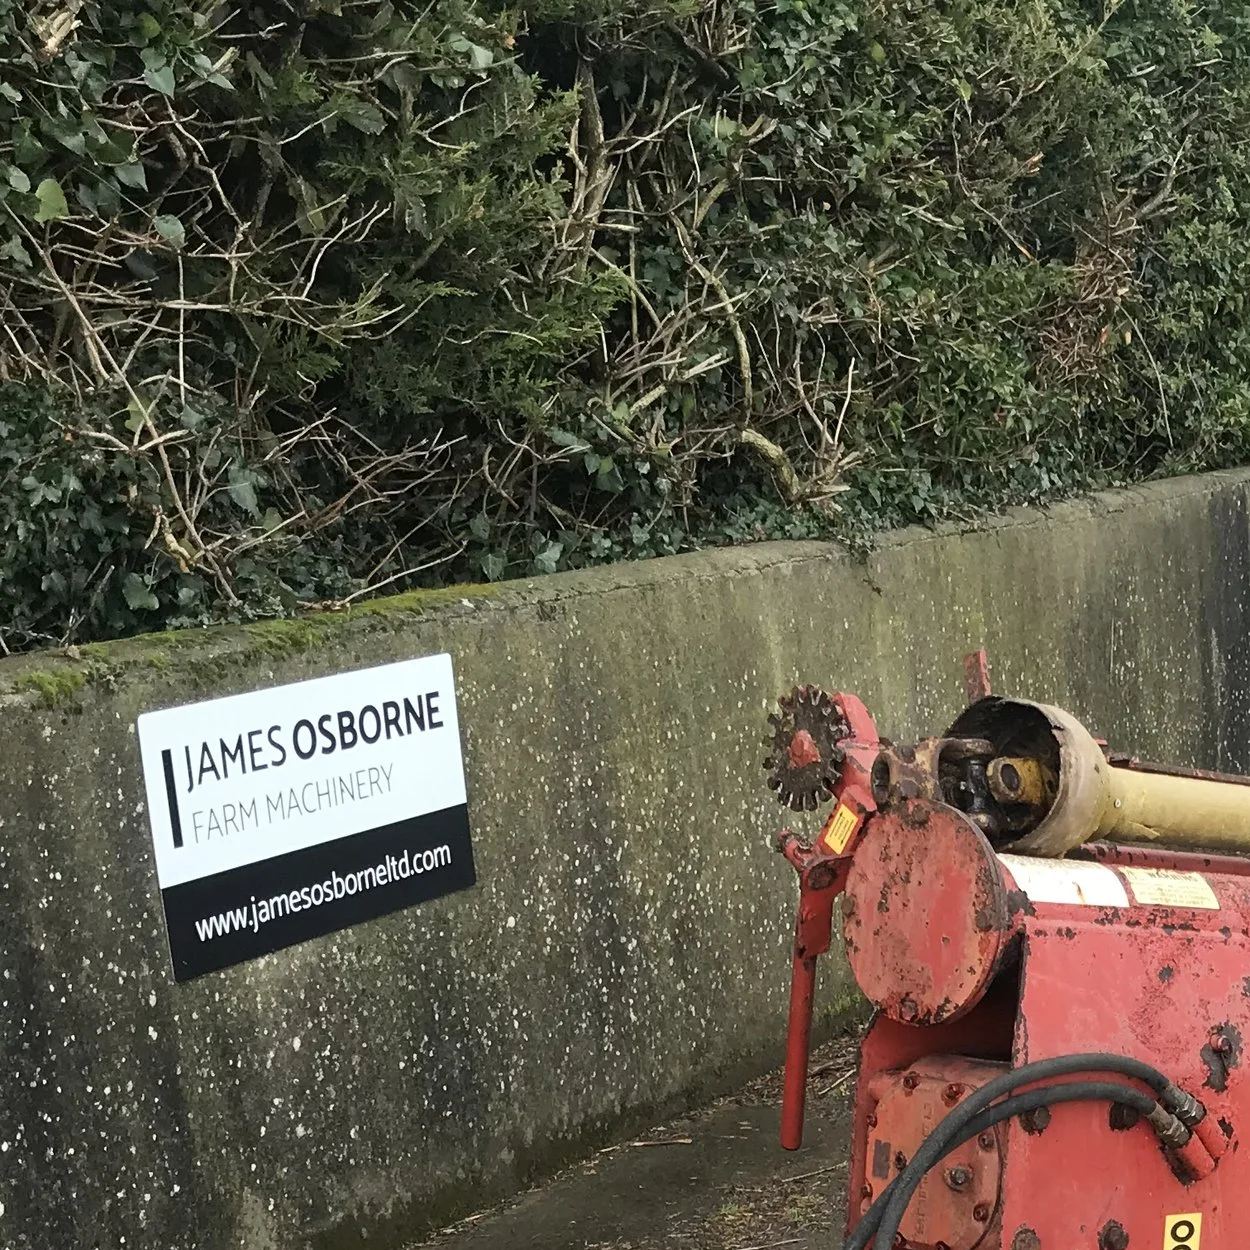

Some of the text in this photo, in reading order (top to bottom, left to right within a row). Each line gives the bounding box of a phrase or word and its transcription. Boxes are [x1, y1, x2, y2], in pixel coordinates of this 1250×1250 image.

[184, 691, 444, 793] JAMES OSBORNE
[192, 762, 394, 844] FARM MACHINERY
[194, 843, 452, 942] www.jamesosborneltd.com
